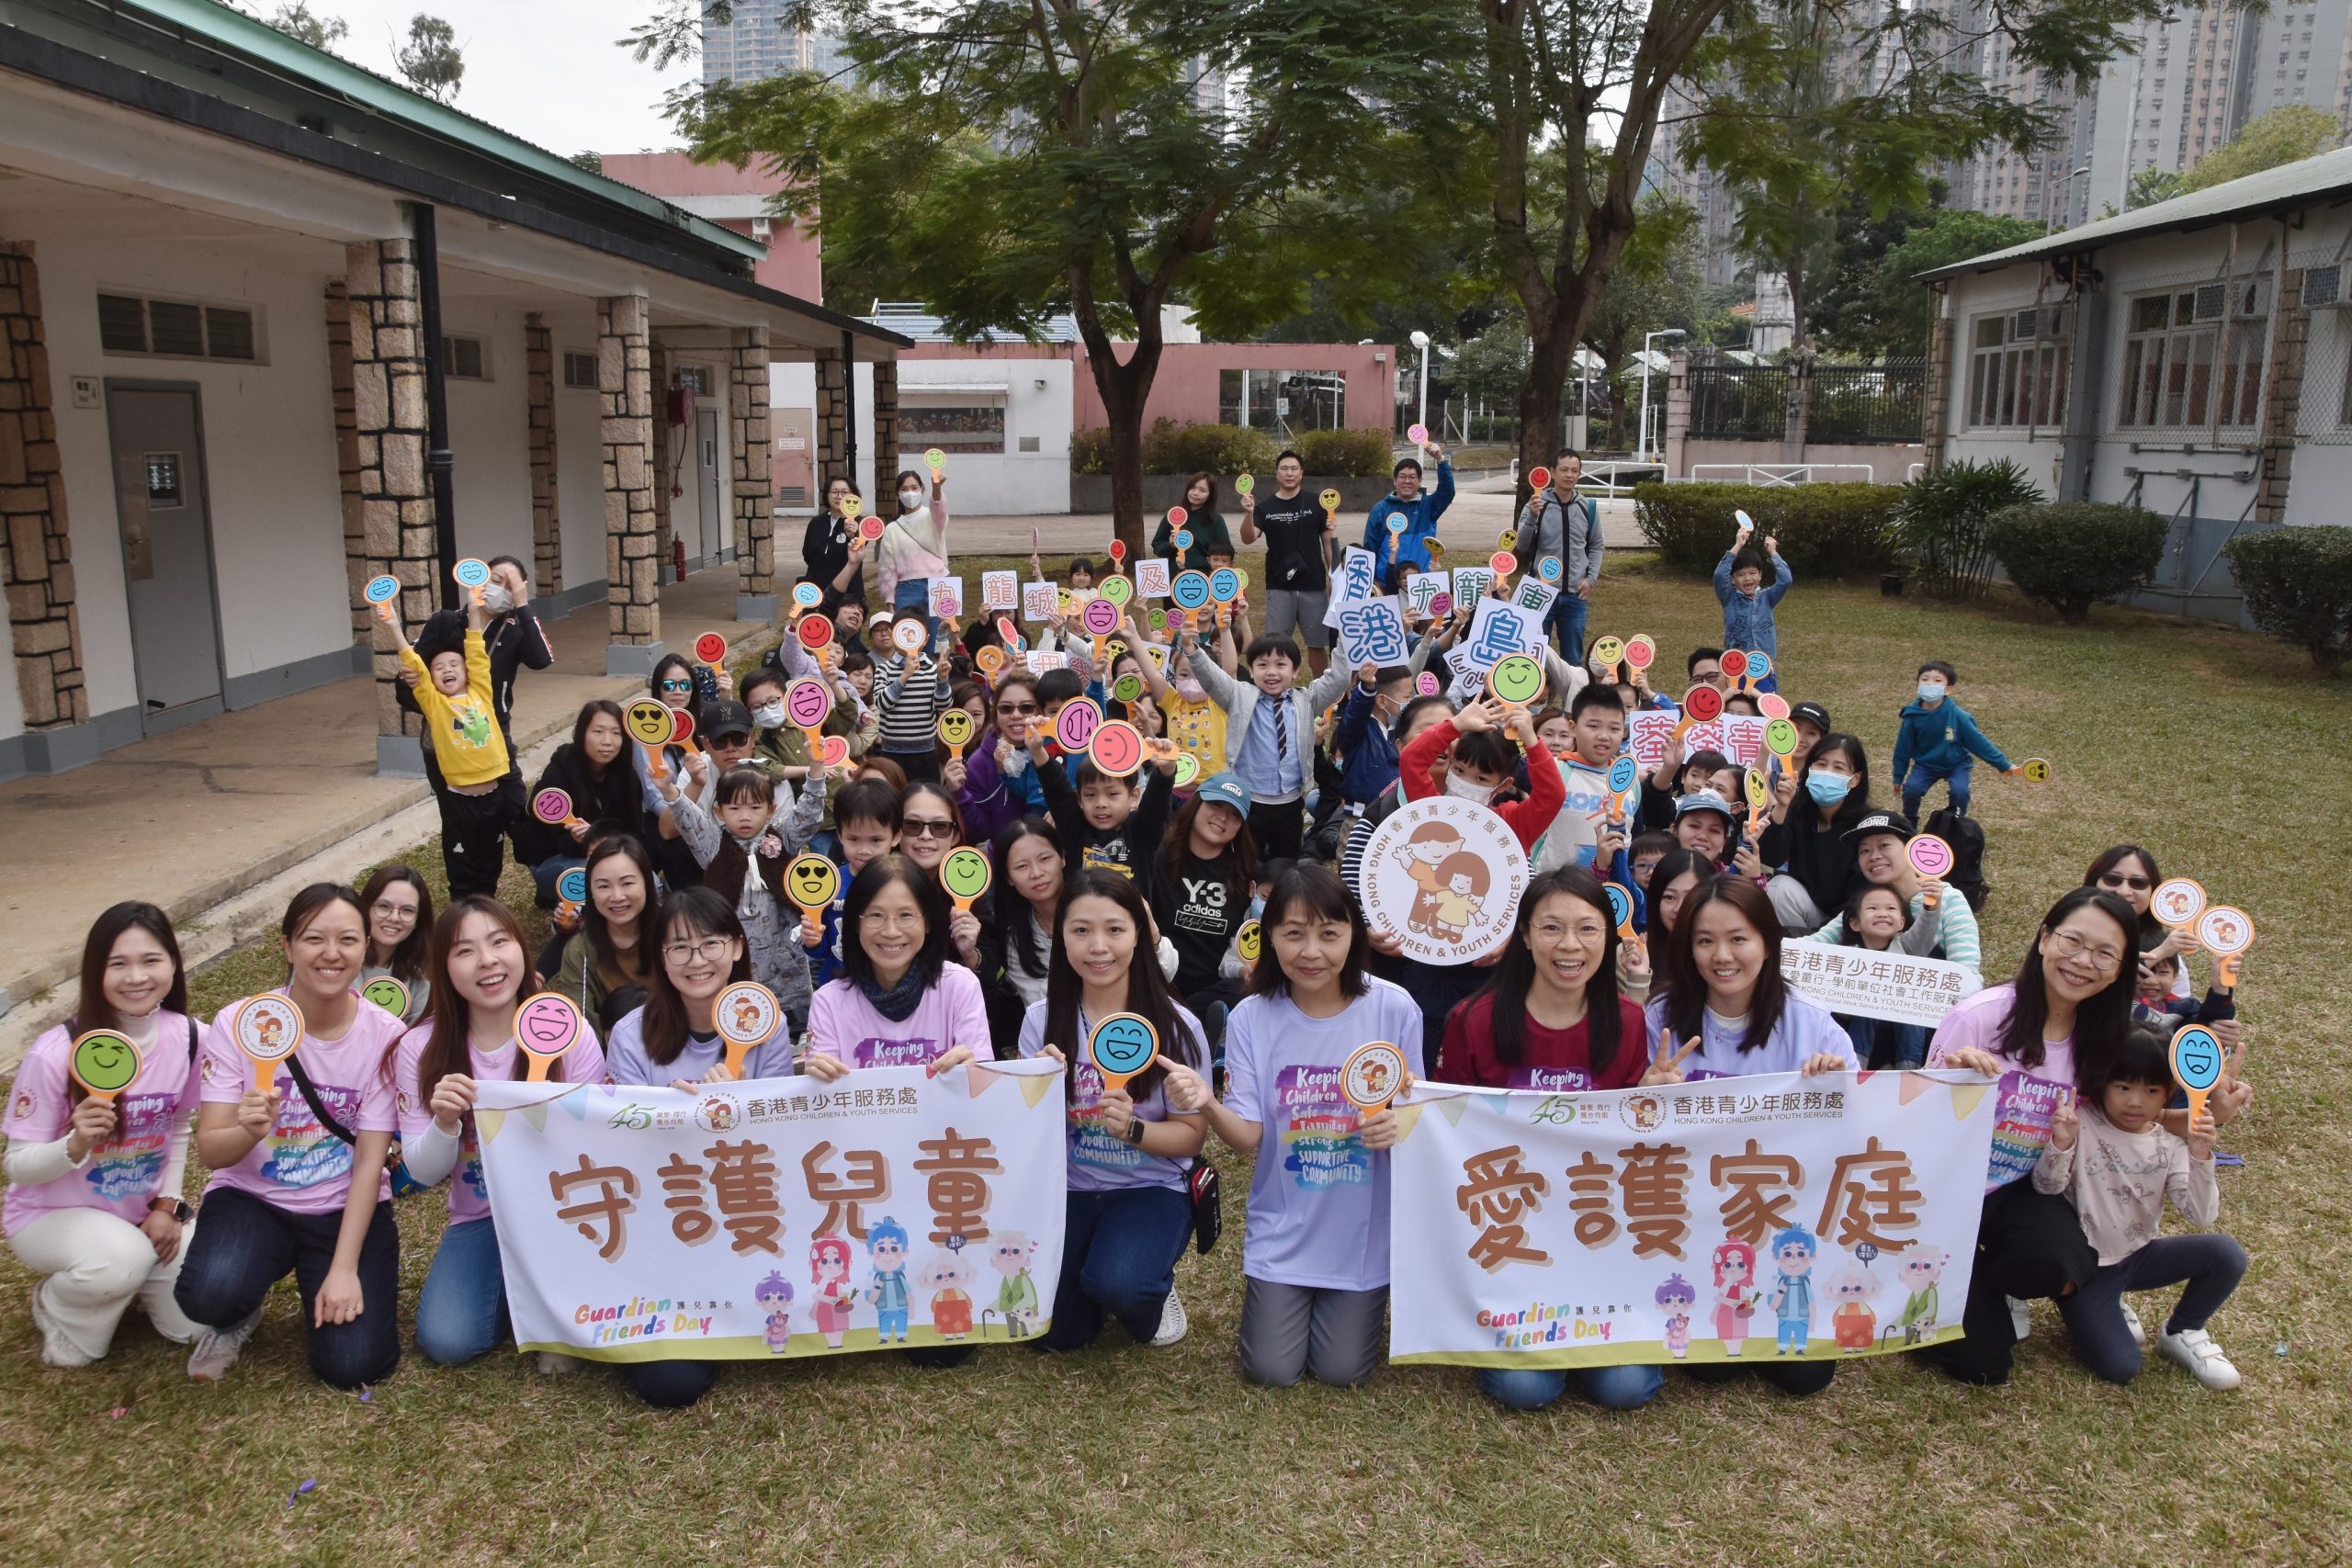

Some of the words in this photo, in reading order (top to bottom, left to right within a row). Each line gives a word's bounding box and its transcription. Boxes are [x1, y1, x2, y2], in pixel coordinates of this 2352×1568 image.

[986, 575, 1015, 606] 龍
[1139, 564, 1169, 594] 及
[1025, 589, 1057, 615] 城
[1340, 604, 1403, 663] 港
[1470, 608, 1527, 666] 島
[1728, 720, 1764, 767] 青
[1390, 805, 1520, 867] 香港青少年服務處
[1369, 834, 1392, 868] HONG
[1182, 877, 1227, 908] Y-3
[1367, 874, 1380, 908] KONG
[1492, 874, 1521, 935] SERVICES
[1183, 903, 1222, 918] adidas
[1376, 912, 1432, 956] CHILDREN
[1452, 934, 1492, 956] YOUTH
[1437, 948, 1446, 957] &
[1781, 948, 1962, 993] 香港青少年服務處
[1801, 986, 1826, 996] KONG
[1827, 989, 1871, 1002] CHILDREN
[1881, 998, 1910, 1008] YOUTH
[1913, 1003, 1950, 1014] SERVICE
[875, 1041, 924, 1063] Keeping
[1074, 1064, 1105, 1086] Keep
[1296, 1067, 1342, 1091] Keepi
[1530, 1067, 1584, 1091] Keeping
[747, 1087, 918, 1118] 香港青少年服務處
[1286, 1089, 1338, 1105] Children
[1529, 1095, 1579, 1125] 45
[1673, 1091, 1844, 1115] 香港青少年服務處
[2006, 1094, 2050, 1113] Children
[606, 1103, 658, 1130] 45
[800, 1111, 841, 1121] CHILDREN
[878, 1107, 918, 1115] SERVICES
[1292, 1105, 1318, 1121] Safe
[1725, 1115, 1766, 1123] CHILDREN
[1074, 1145, 1141, 1166] COMMUNITY
[548, 1126, 1005, 1262] 守護兒童
[1456, 1136, 1926, 1274] 愛護家庭
[574, 1296, 672, 1325] Guardian
[1476, 1302, 1571, 1327] Guardian
[592, 1314, 666, 1345] Friends
[673, 1314, 712, 1335] Day
[1495, 1321, 1567, 1348] Friends
[1574, 1319, 1611, 1340] Day
